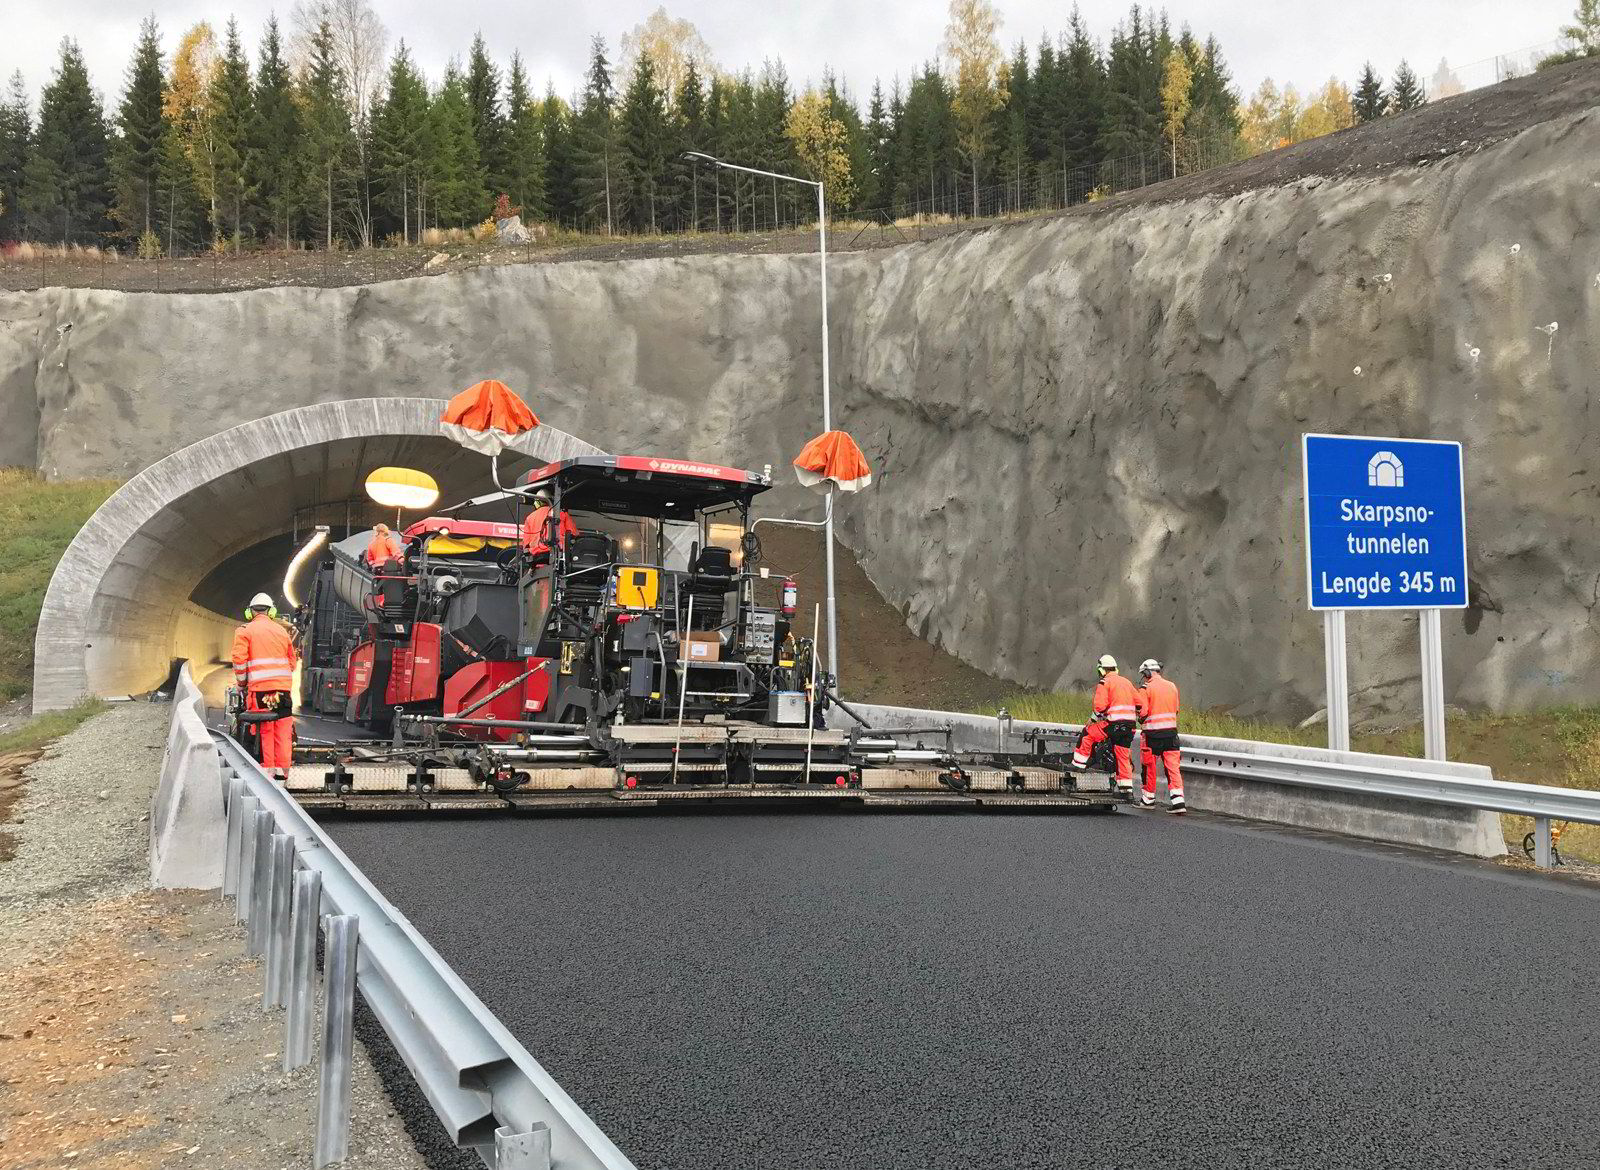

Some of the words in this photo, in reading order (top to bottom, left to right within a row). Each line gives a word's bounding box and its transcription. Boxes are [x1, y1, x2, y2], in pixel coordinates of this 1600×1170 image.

[660, 462, 721, 476] DYNAPAC
[1340, 499, 1434, 527] Skarpsno-
[1347, 532, 1429, 554] tunnelen
[1322, 571, 1391, 599] Lengde
[1399, 571, 1434, 593] 345
[1440, 576, 1455, 592] m
